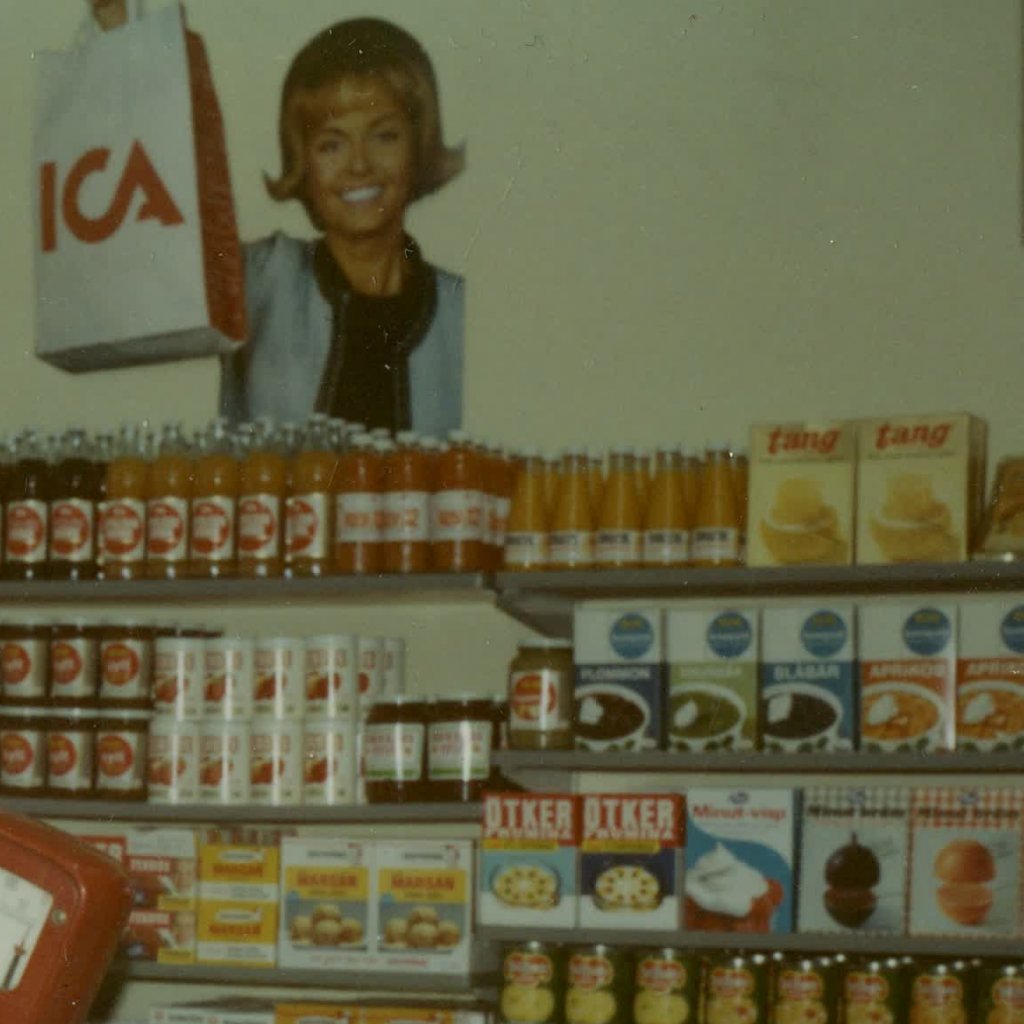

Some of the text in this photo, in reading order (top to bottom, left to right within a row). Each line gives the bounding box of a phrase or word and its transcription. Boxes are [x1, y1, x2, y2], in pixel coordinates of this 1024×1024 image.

[40, 138, 184, 254] ICA
[768, 426, 842, 455] tang
[876, 423, 952, 451] tang
